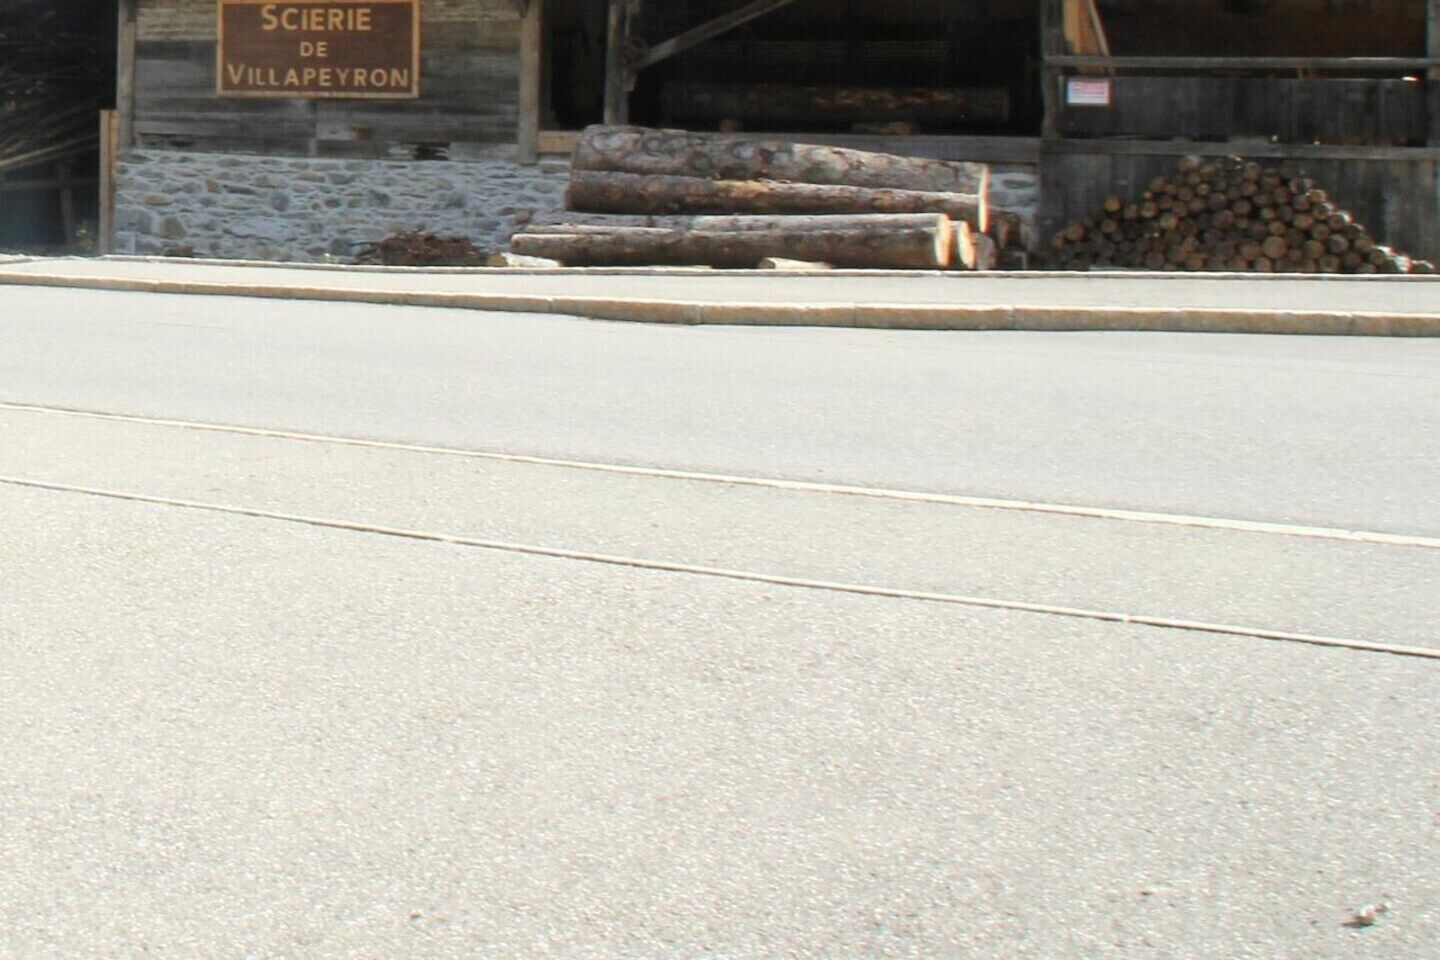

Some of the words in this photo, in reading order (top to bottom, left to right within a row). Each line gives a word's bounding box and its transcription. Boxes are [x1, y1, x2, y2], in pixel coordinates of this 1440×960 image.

[261, 4, 372, 31] SCIERIE
[299, 41, 328, 57] DE
[227, 63, 409, 87] VILLAPEYRON
